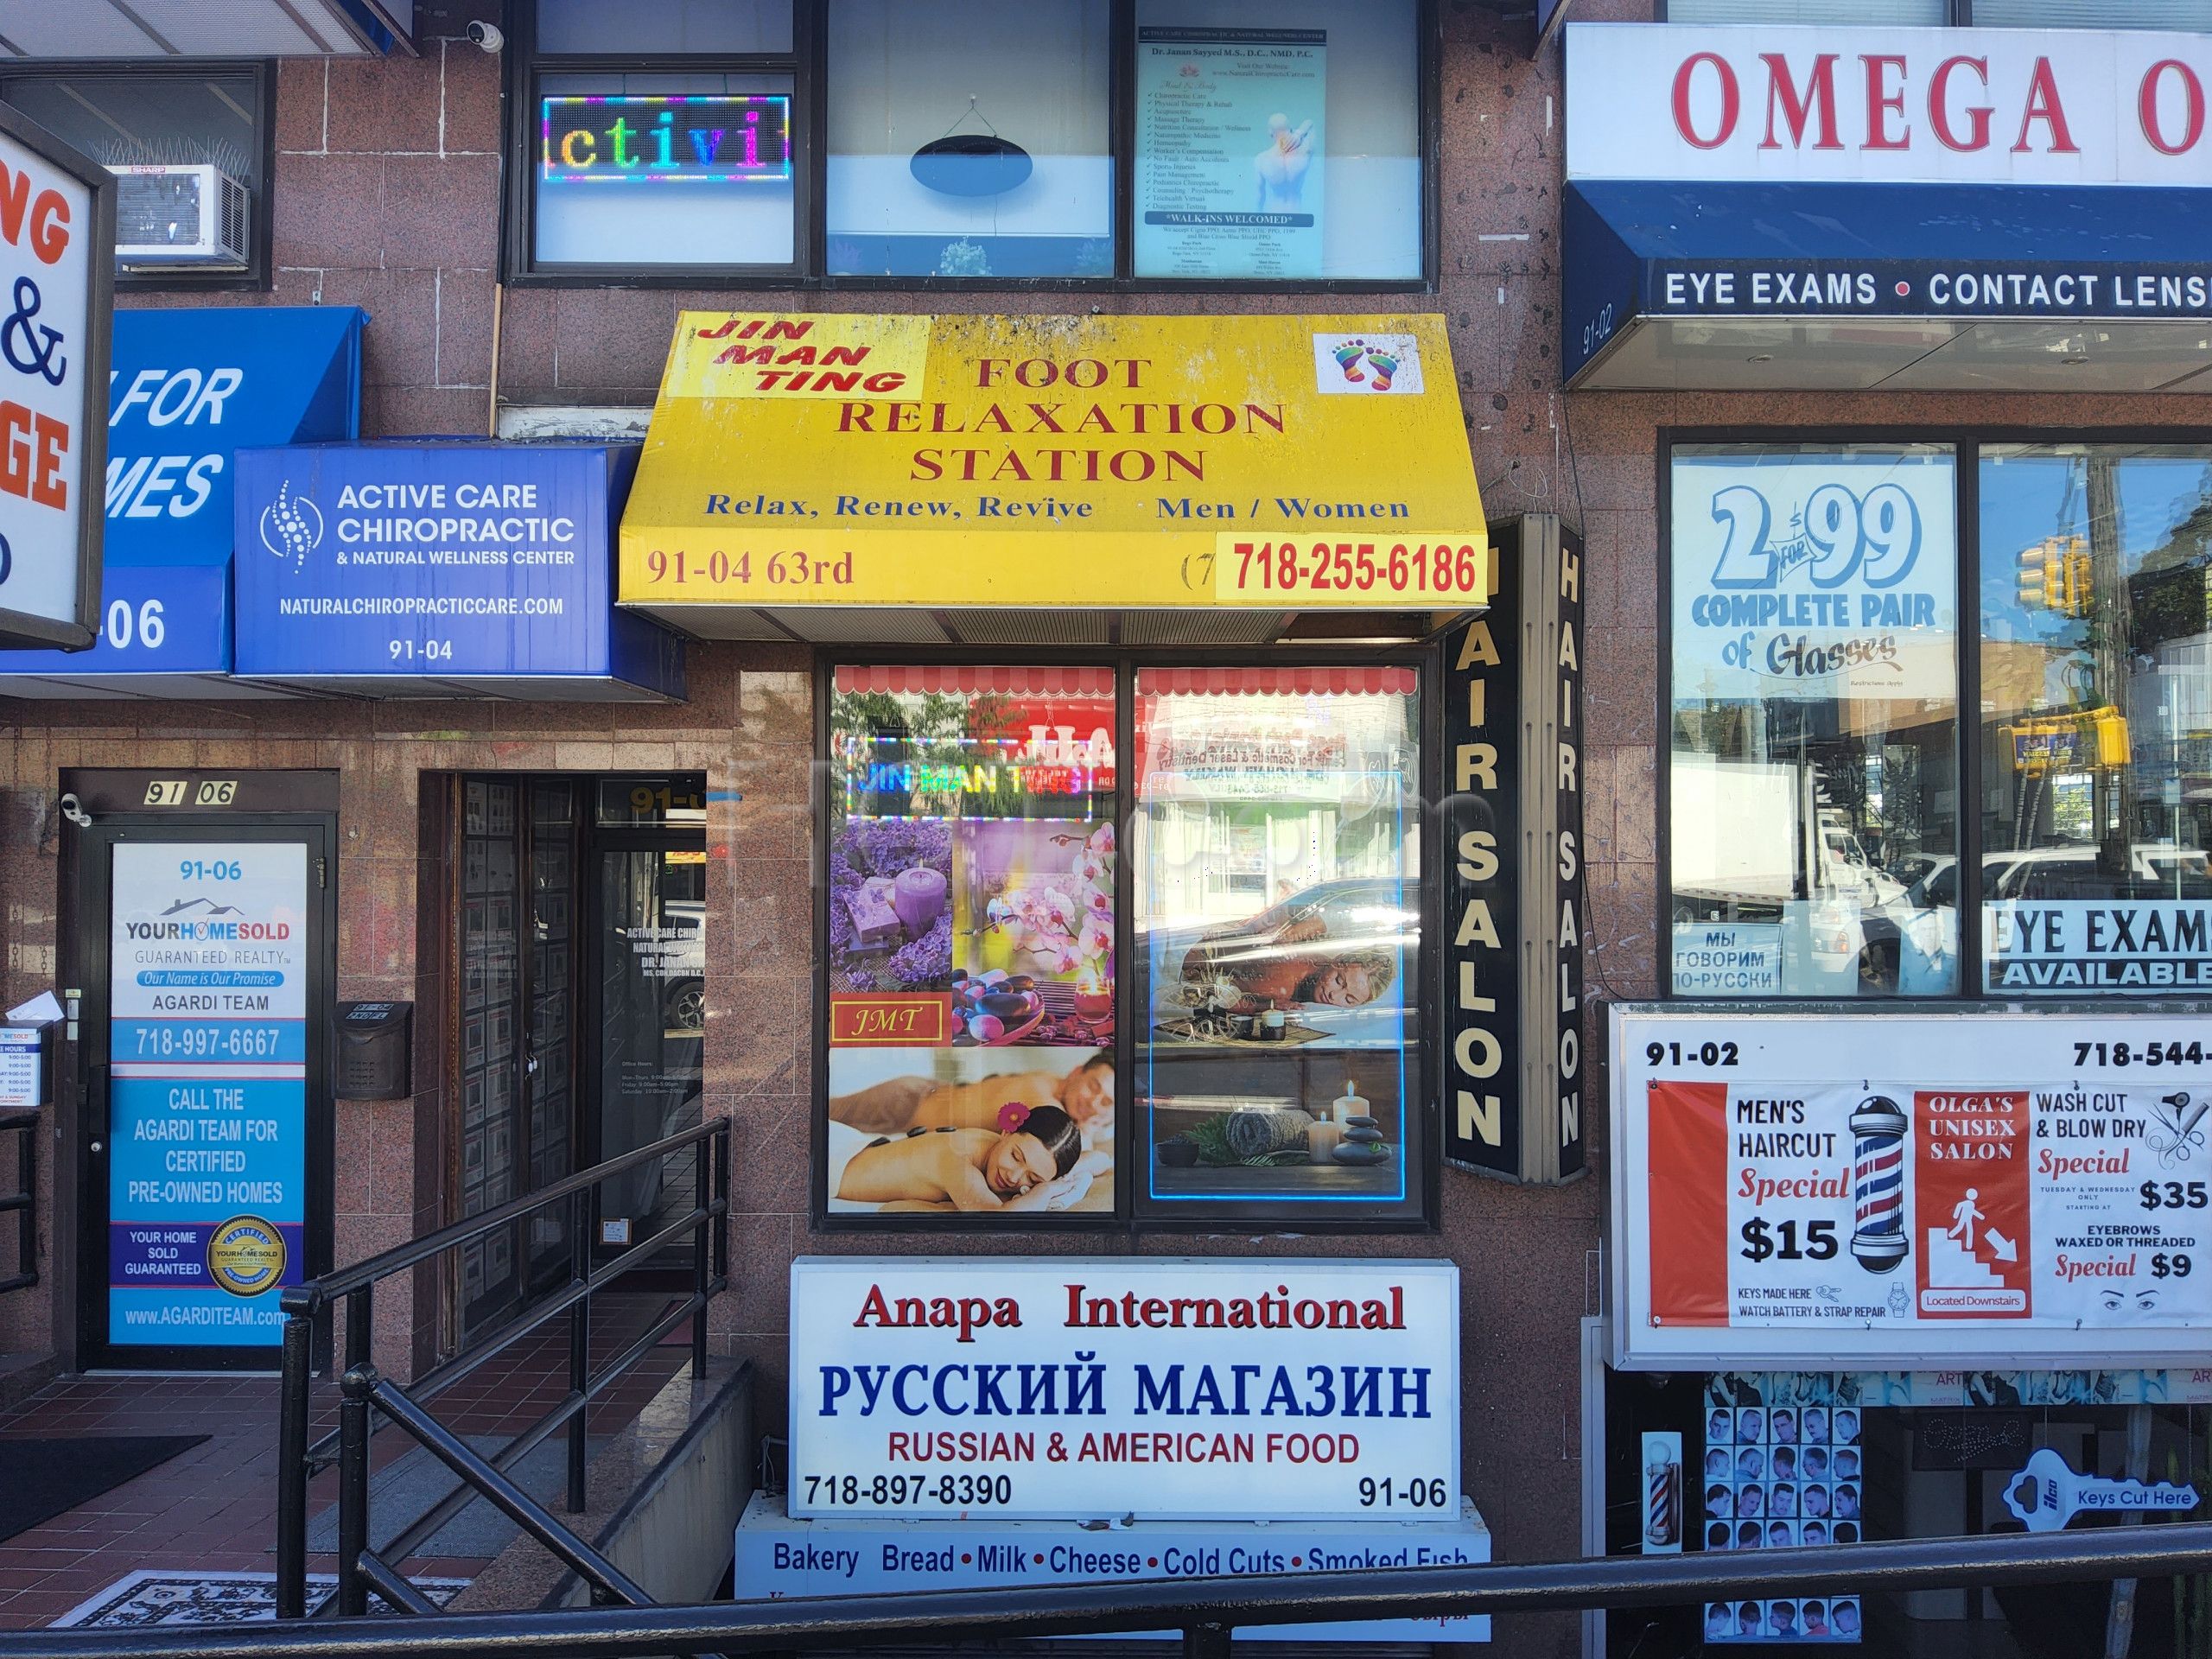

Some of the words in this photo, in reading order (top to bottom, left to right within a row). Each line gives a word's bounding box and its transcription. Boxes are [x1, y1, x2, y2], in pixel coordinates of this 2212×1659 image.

[1152, 48, 1166, 56] Dr.
[1166, 48, 1192, 56] Janan
[1192, 48, 1223, 58] Sayyed
[1671, 52, 2081, 153] OMEGA
[2139, 60, 2205, 156] O
[545, 111, 786, 168] ctivi
[1666, 272, 1736, 304] EYE
[1752, 272, 1877, 305] EXAMS
[1929, 273, 2098, 306] CONTACT
[0, 275, 67, 387] &
[696, 320, 815, 340] JIN
[1581, 302, 1613, 355] 91-02
[713, 345, 872, 365] MAN
[754, 370, 908, 393] TING
[974, 358, 1153, 389] FOOT
[109, 368, 244, 427] FOR
[834, 402, 1287, 435] RELAXATION
[910, 448, 1205, 482] STATION
[336, 484, 446, 509] ACTIVE
[454, 484, 537, 509] CARE
[703, 493, 819, 518] Relax,
[833, 495, 962, 520] Renew,
[976, 496, 1094, 518] Revive
[1155, 497, 1236, 518] Men
[1249, 498, 1260, 518] /
[1274, 498, 1410, 518] Women
[337, 518, 575, 543] CHIROPRACTIC
[1711, 485, 1777, 589] 2
[337, 551, 348, 565] &
[353, 551, 425, 564] NATURAL
[429, 551, 508, 564] WELLNESS
[512, 551, 575, 564] CENTER
[647, 550, 752, 585] 91-04
[766, 550, 855, 585] 63rd
[1234, 542, 1477, 593] 718-255-6186
[280, 597, 563, 614] NATURALCHIROPRACTICCARE.COM
[1691, 594, 1850, 627] COMPLETE
[1861, 593, 1936, 627] PAIR
[389, 640, 453, 660] 91-04
[1721, 631, 1756, 670] of
[1766, 633, 1897, 677] Glasses
[1558, 547, 1580, 791] HAIR
[858, 764, 912, 792] JIN
[920, 764, 996, 793] MAN
[147, 782, 180, 804] 91
[200, 782, 234, 804] 06
[179, 861, 242, 880] 91-06
[125, 919, 290, 941] YOURHOMESOLD
[626, 927, 658, 939] ACTIVE
[658, 927, 677, 939] CARE
[1706, 932, 1736, 947] МЫ
[1990, 910, 2066, 953] EYE
[2085, 909, 2212, 952] EXAM
[135, 950, 228, 964] GUARANTEED
[234, 950, 284, 964] REALTY
[641, 957, 658, 968] DR.
[1675, 951, 1764, 967] ГОВОРИМ
[144, 973, 167, 985] Our
[168, 973, 198, 985] Name
[200, 973, 209, 985] is
[210, 973, 231, 985] Our
[232, 973, 276, 985] Promise
[1453, 830, 1503, 1147] SALON
[1558, 830, 1580, 1147] SALON
[152, 995, 218, 1011] AGARDI
[225, 995, 270, 1011] TEAM
[850, 1007, 924, 1036] JMT
[136, 1028, 280, 1055] 718-997-6667
[1646, 1041, 1739, 1066] 91-02
[168, 1088, 210, 1110] CALL
[213, 1088, 245, 1110] THE
[1929, 1096, 2013, 1114] OLGA'S
[2036, 1092, 2088, 1113] WASH
[2093, 1093, 2128, 1112] CUT
[1737, 1099, 1805, 1124] MEN'S
[134, 1119, 194, 1141] AGARDI
[199, 1119, 242, 1141] TEAM
[245, 1120, 278, 1141] FOR
[1929, 1119, 2017, 1137] UNISEX
[2036, 1119, 2049, 1138] &
[2056, 1119, 2107, 1138] BLOW
[2113, 1119, 2146, 1138] DRY
[1738, 1133, 1837, 1159] HAIRCUT
[1930, 1142, 2013, 1160] SALON
[165, 1150, 246, 1173] CERTIFIED
[2037, 1147, 2130, 1181] Special
[129, 1181, 223, 1204] PRE-OWNED
[226, 1181, 283, 1204] HOMES
[1738, 1166, 1850, 1206] Special
[2139, 1179, 2209, 1211] $35
[130, 1231, 162, 1243] YOUR
[163, 1231, 197, 1243] HOME
[225, 1228, 270, 1244] CERTIFIED
[1740, 1217, 1839, 1263] $15
[2087, 1224, 2160, 1236] EYEBROWS
[148, 1248, 179, 1259] SOLD
[2055, 1237, 2103, 1248] WAXED
[2106, 1237, 2124, 1248] OR
[2126, 1237, 2196, 1248] THREADED
[124, 1262, 201, 1275] GUARANTEED
[2055, 1253, 2137, 1283] Special
[2151, 1252, 2193, 1280] $9
[1738, 1287, 1761, 1300] KEYS
[1763, 1287, 1787, 1300] MADE
[1789, 1287, 1812, 1300] HERE
[1926, 1295, 1966, 1306] Located
[1967, 1295, 2020, 1306] Downstairs
[125, 1306, 286, 1325] www.AGARDITEAM.com
[852, 1283, 1023, 1343] Anapa
[1063, 1284, 1408, 1331] International
[1738, 1306, 1770, 1318] WATCH
[1771, 1306, 1814, 1318] BATTERY
[1815, 1306, 1822, 1318] &
[1823, 1306, 1853, 1318] STRAP
[1853, 1306, 1886, 1318] REPAIR
[818, 1351, 1107, 1417] РУССКИЙ
[1133, 1364, 1433, 1419] МАГАЗИН
[887, 1432, 1035, 1463] RUSSIAN
[1046, 1433, 1070, 1463] &
[1077, 1433, 1255, 1464] AMERICAN
[1267, 1433, 1361, 1464] FOOD
[804, 1474, 1013, 1506] 718-897-8390
[1358, 1476, 1447, 1508] 91-06
[2044, 1480, 2057, 1511] ilco
[2077, 1491, 2116, 1507] Keys
[2120, 1491, 2150, 1506] Cut
[2153, 1491, 2192, 1506] Here
[773, 1542, 860, 1578] Bakery
[881, 1543, 954, 1573] Bread
[976, 1544, 1027, 1573] Milk
[1049, 1545, 1141, 1574] Cheese
[1163, 1547, 1220, 1575] Cold
[1229, 1547, 1286, 1573] Cuts
[1307, 1548, 1416, 1572] Smoked
